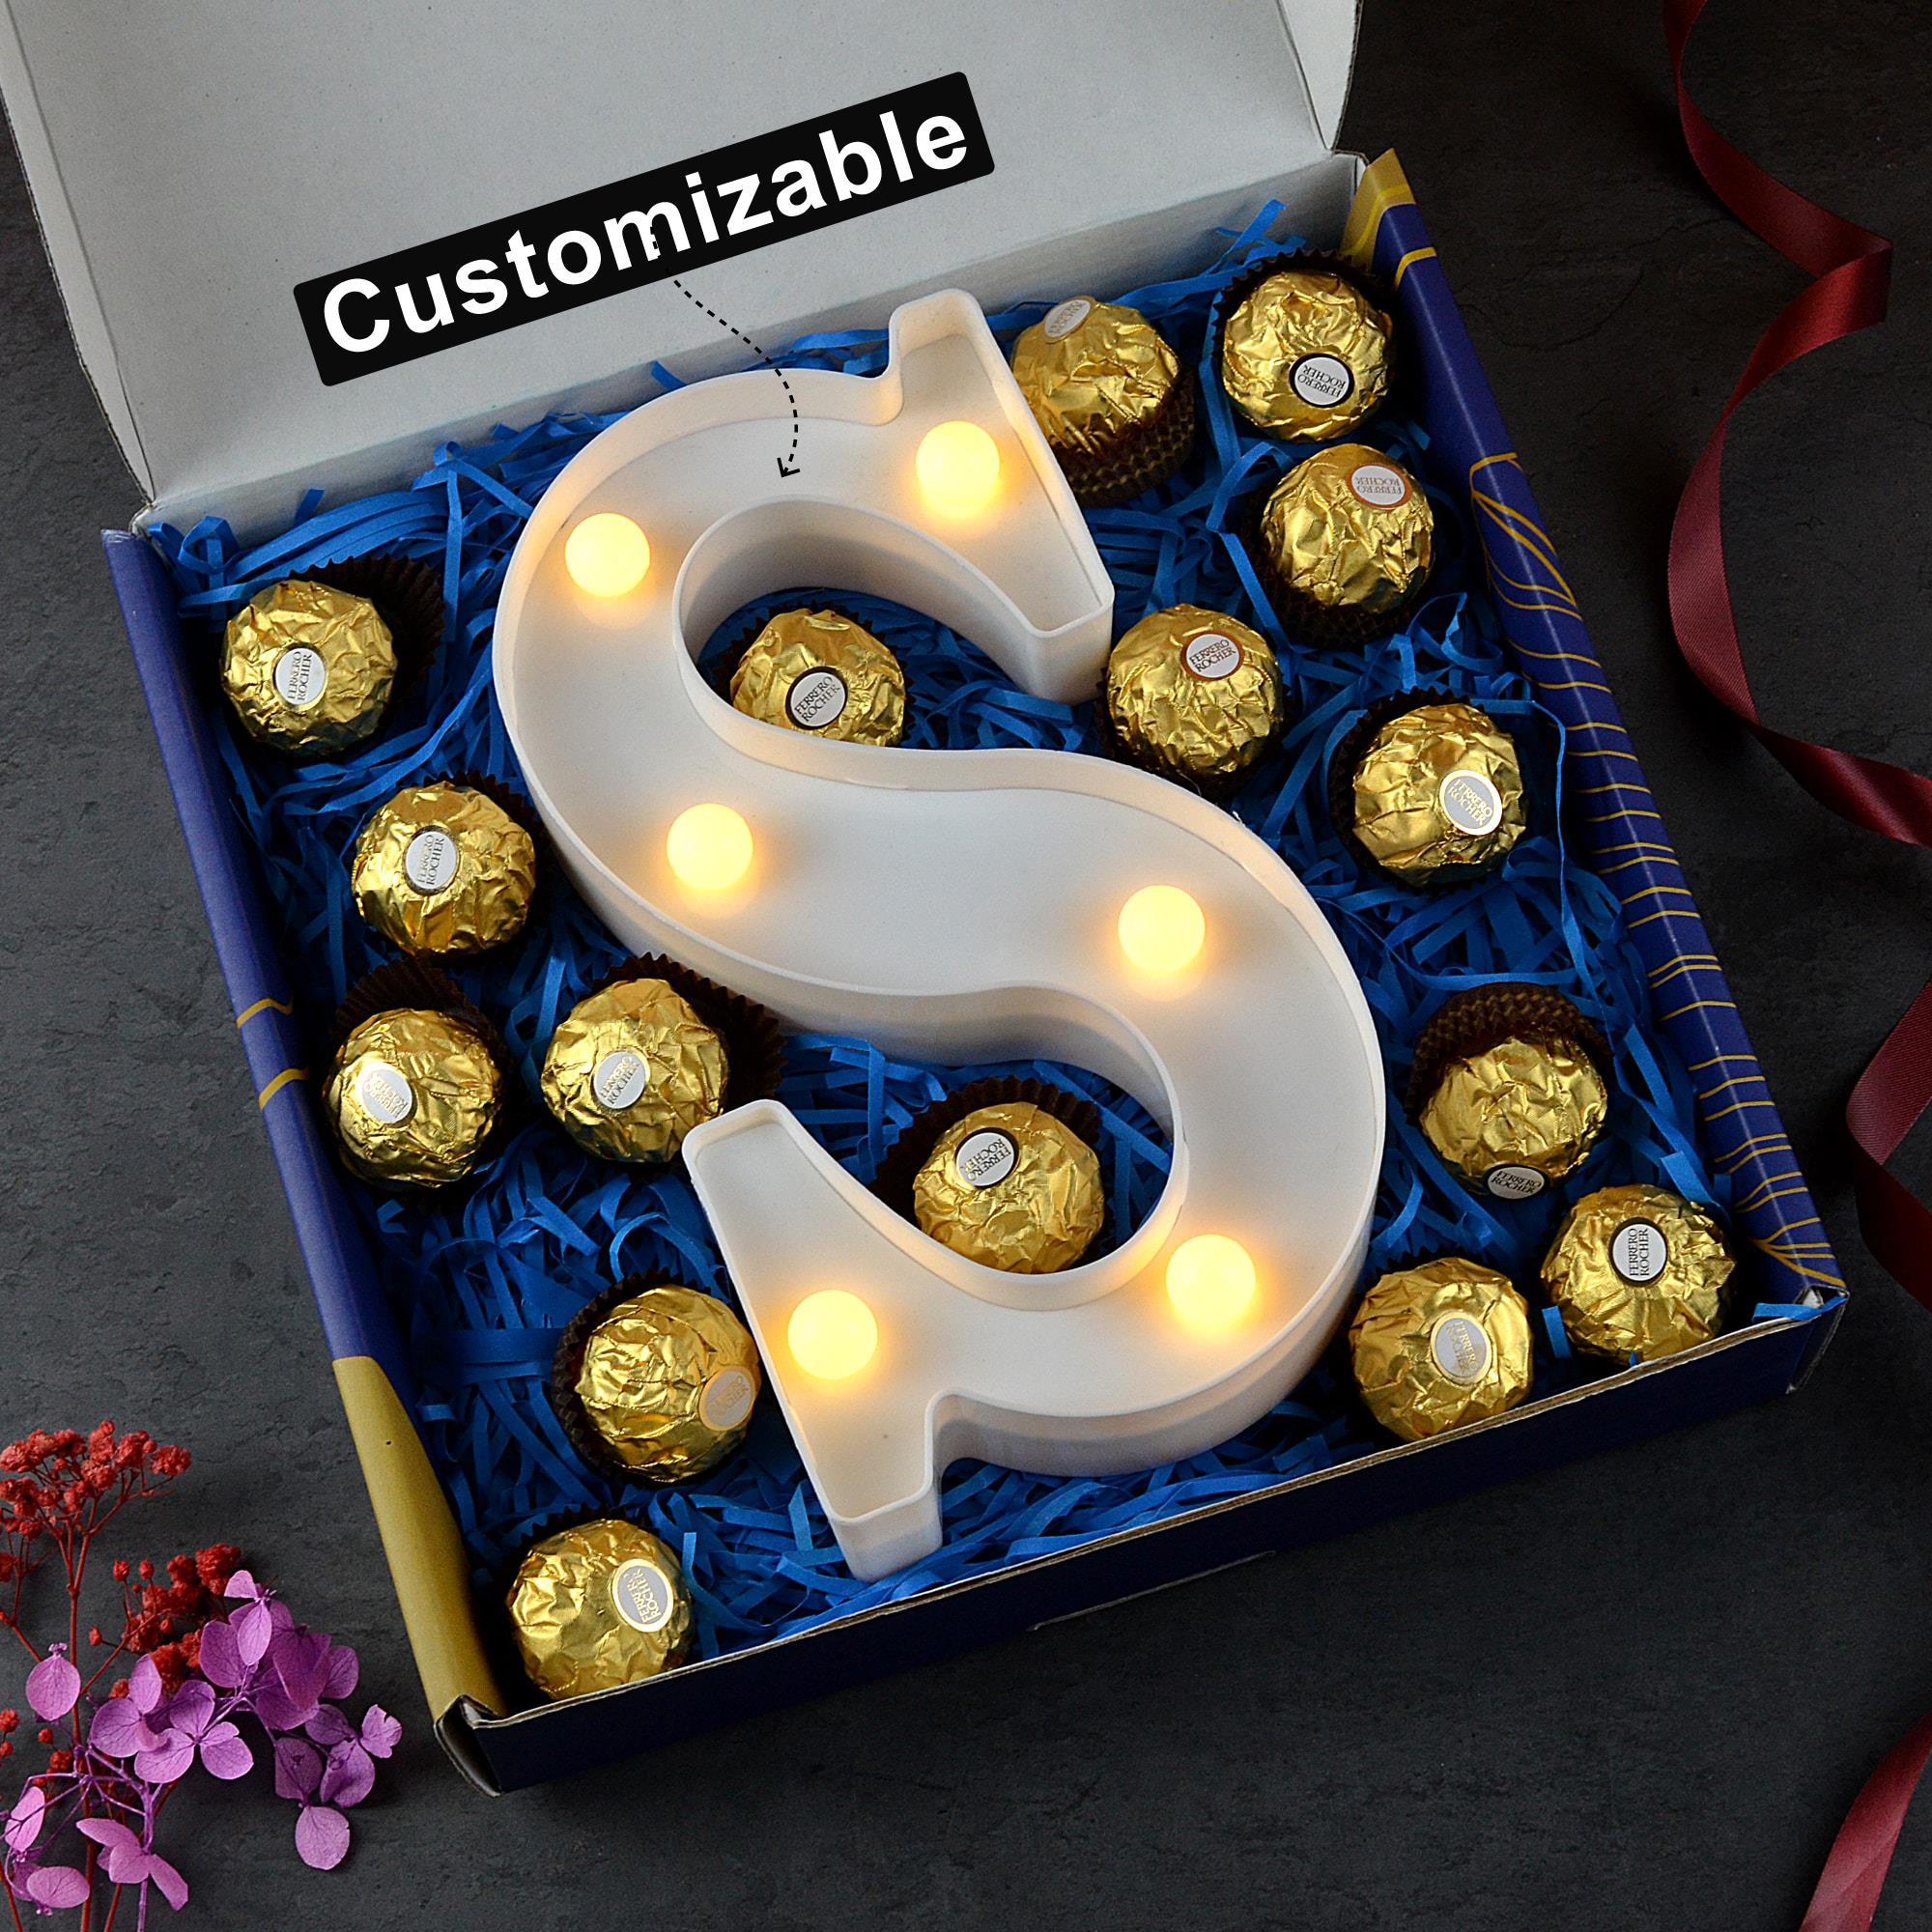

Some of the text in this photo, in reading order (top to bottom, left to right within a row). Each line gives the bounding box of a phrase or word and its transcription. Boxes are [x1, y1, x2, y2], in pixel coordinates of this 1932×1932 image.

[1297, 374, 1342, 398] FERRERO
[1302, 364, 1347, 389] ROCHER
[1355, 476, 1401, 486] ROCHER
[1356, 485, 1402, 495] FERRERO
[1189, 639, 1230, 666] FERRERO
[1194, 646, 1236, 672] ROCHER
[288, 651, 301, 700] FERRERO
[297, 653, 313, 700] ROCHER
[794, 676, 834, 715] FERRERO
[801, 683, 841, 723] ROCHER
[1448, 786, 1487, 826] ROCHER
[1453, 779, 1492, 818] FERRERO
[426, 837, 445, 886] ROCHER
[960, 1138, 1006, 1173] ROCHER
[967, 1145, 1011, 1181] FERRERO
[1491, 1176, 1536, 1194] ROCHER
[1495, 1170, 1542, 1188] FERRERO
[1628, 1228, 1639, 1276] FERRERO
[1638, 1228, 1650, 1276] ROCHER
[633, 1568, 663, 1618] ROCHER
